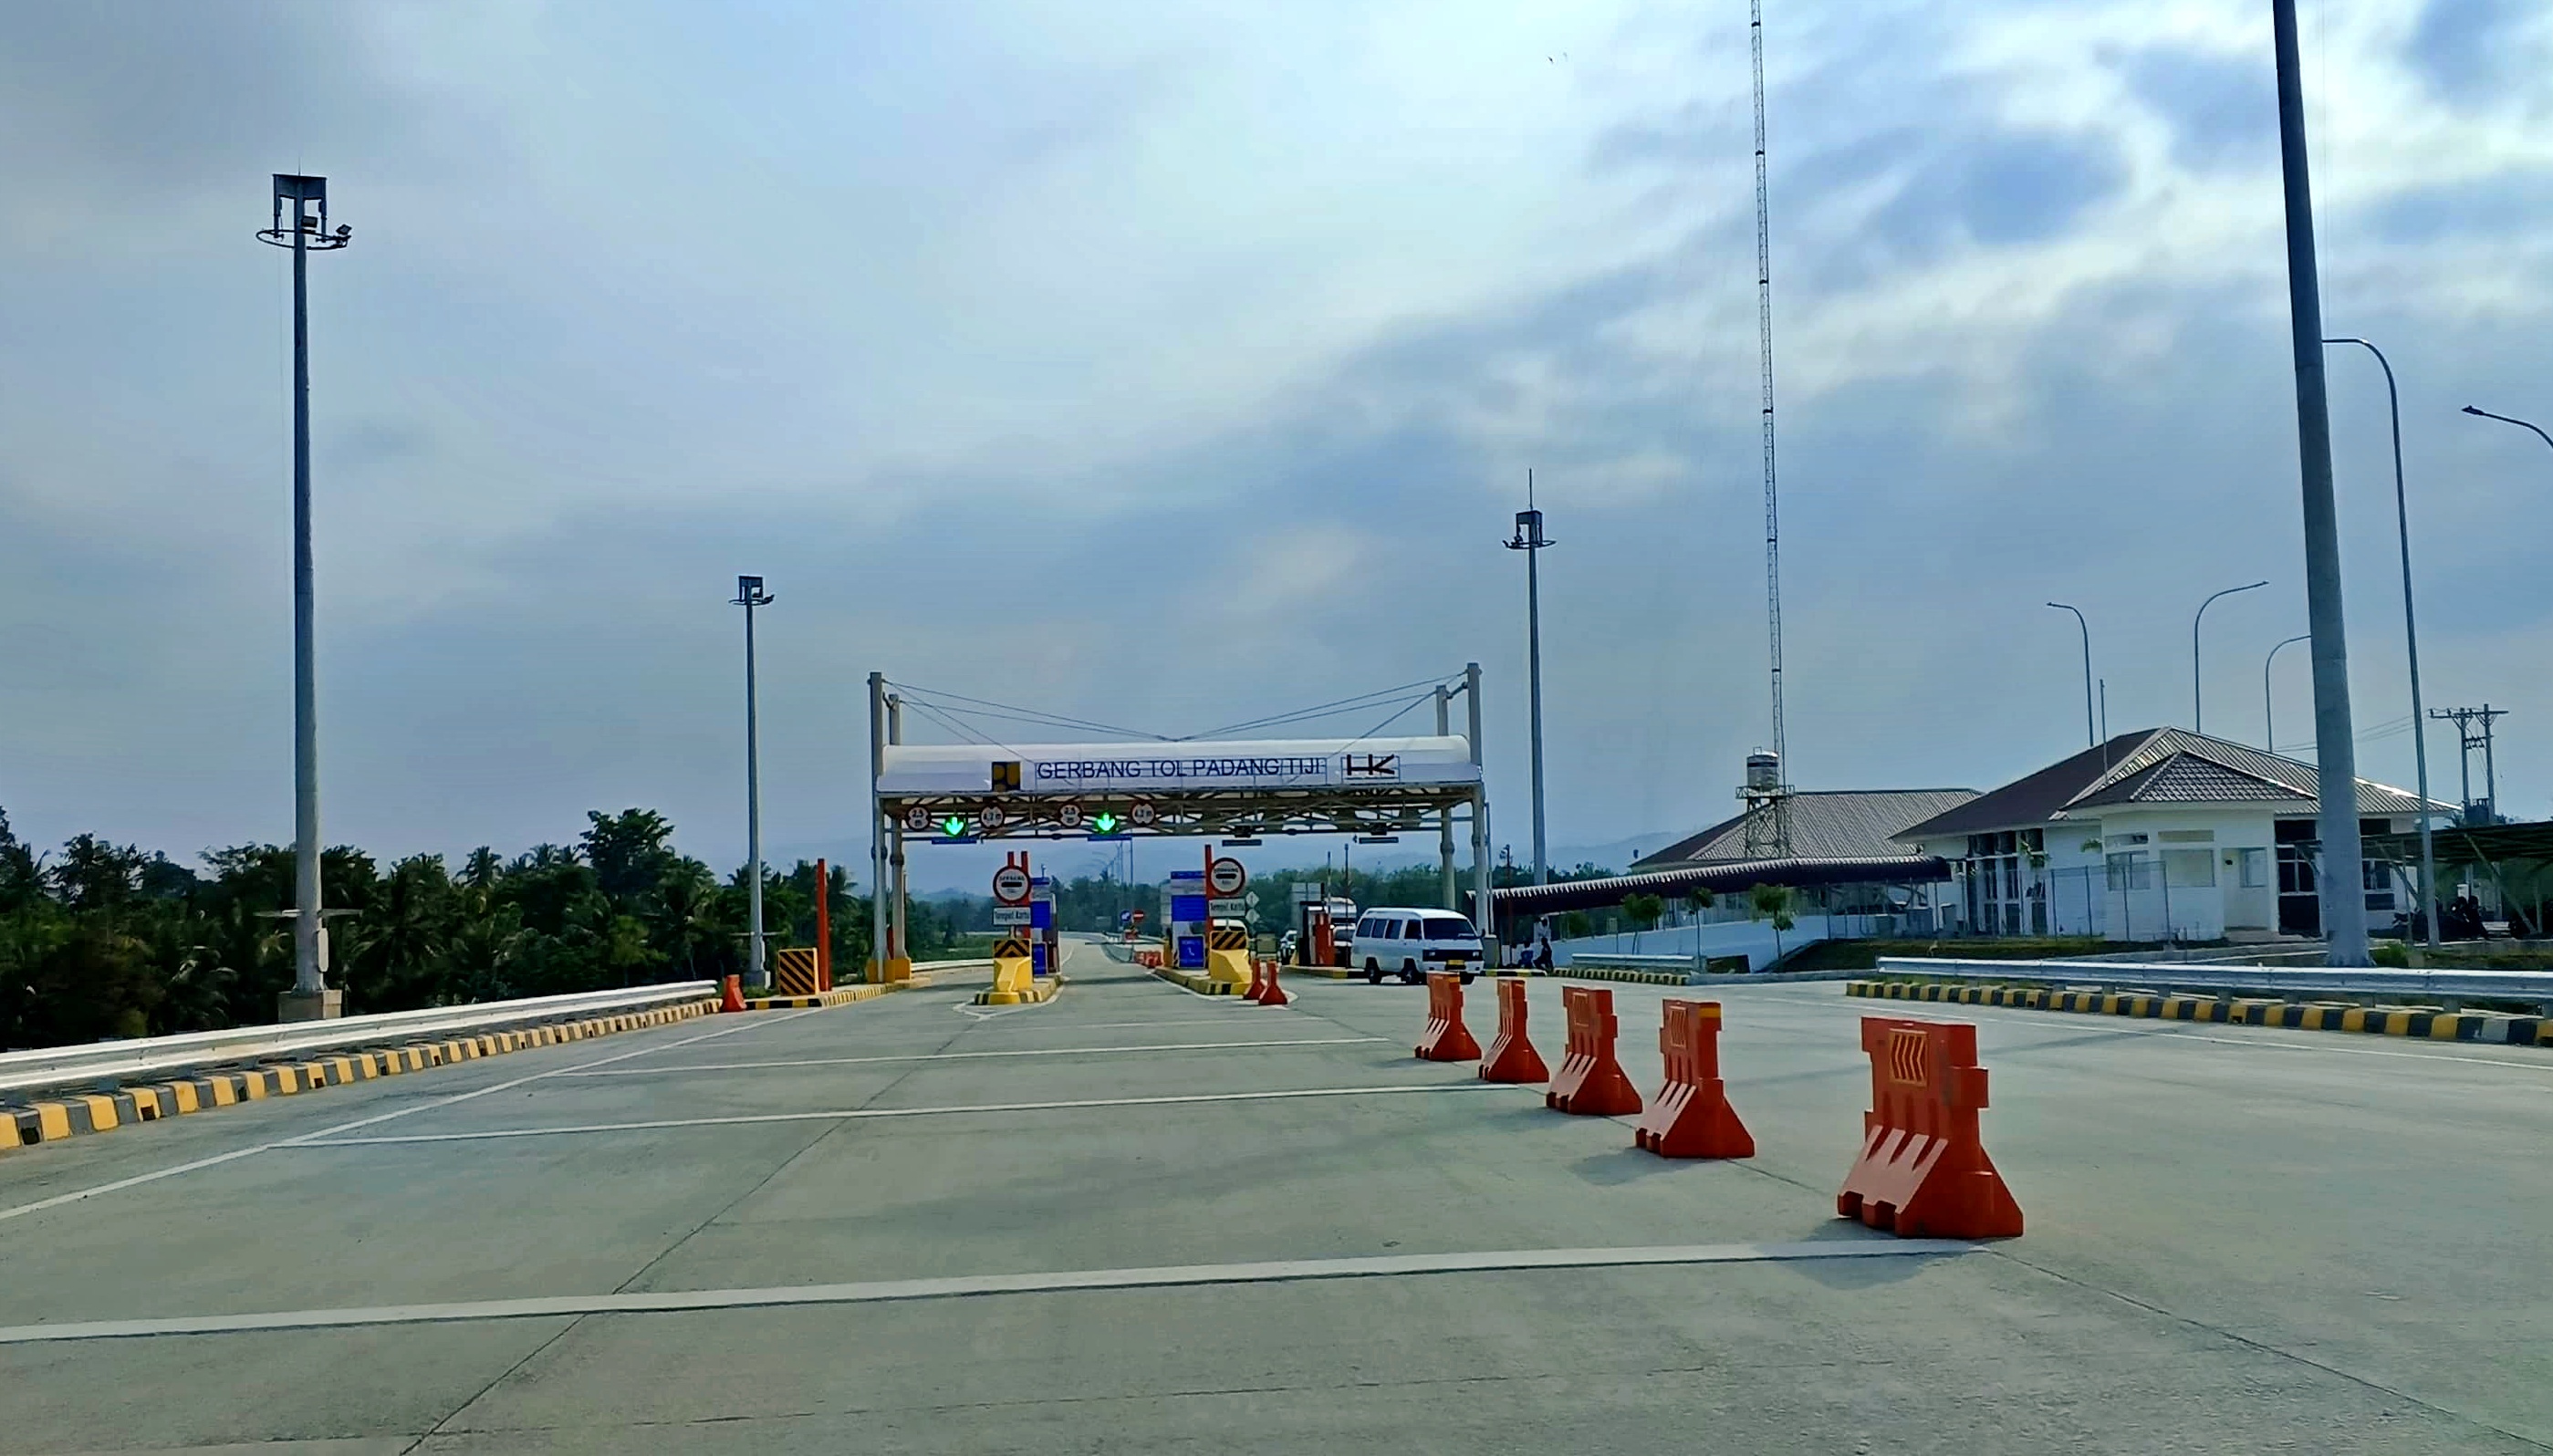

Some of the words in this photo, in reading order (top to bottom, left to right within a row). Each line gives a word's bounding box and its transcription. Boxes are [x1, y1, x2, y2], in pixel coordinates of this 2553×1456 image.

[1037, 761, 1141, 779] GERBANG
[1151, 759, 1187, 777] TOL
[1193, 758, 1279, 776] PADANG
[1286, 757, 1319, 775] TIJI
[1346, 754, 1395, 776] HK
